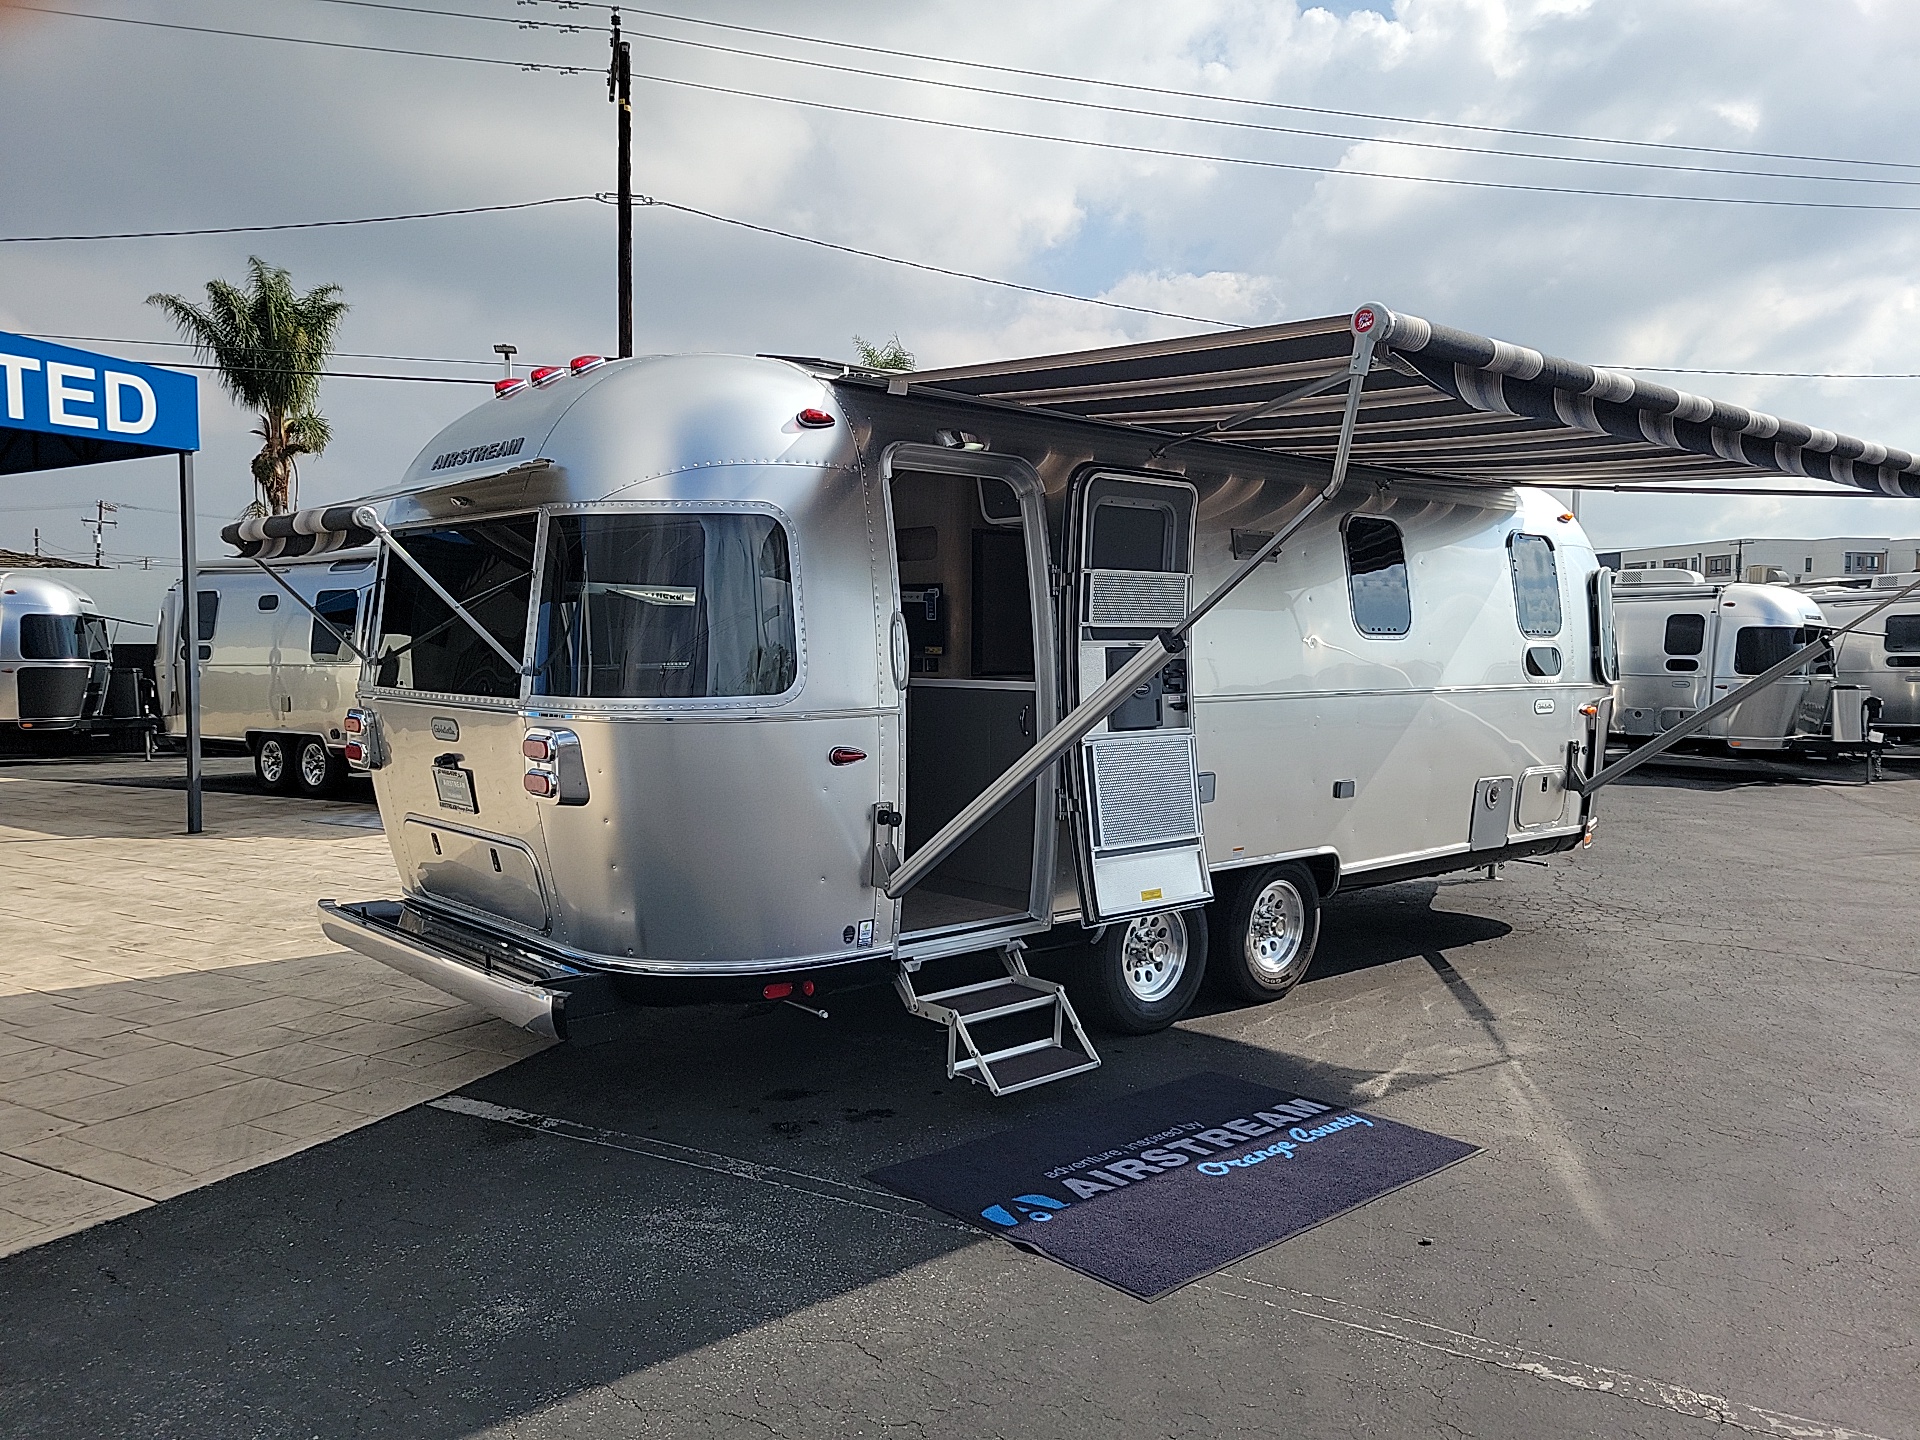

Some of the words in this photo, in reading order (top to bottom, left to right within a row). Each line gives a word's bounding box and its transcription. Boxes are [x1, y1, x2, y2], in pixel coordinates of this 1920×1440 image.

[431, 437, 525, 471] AIRSTREAM
[1061, 1098, 1332, 1200] AIRSTREAM
[1121, 1126, 1183, 1153] inspired
[1178, 1119, 1206, 1136] by
[1197, 1140, 1298, 1176] Orange
[1289, 1113, 1374, 1143] County
